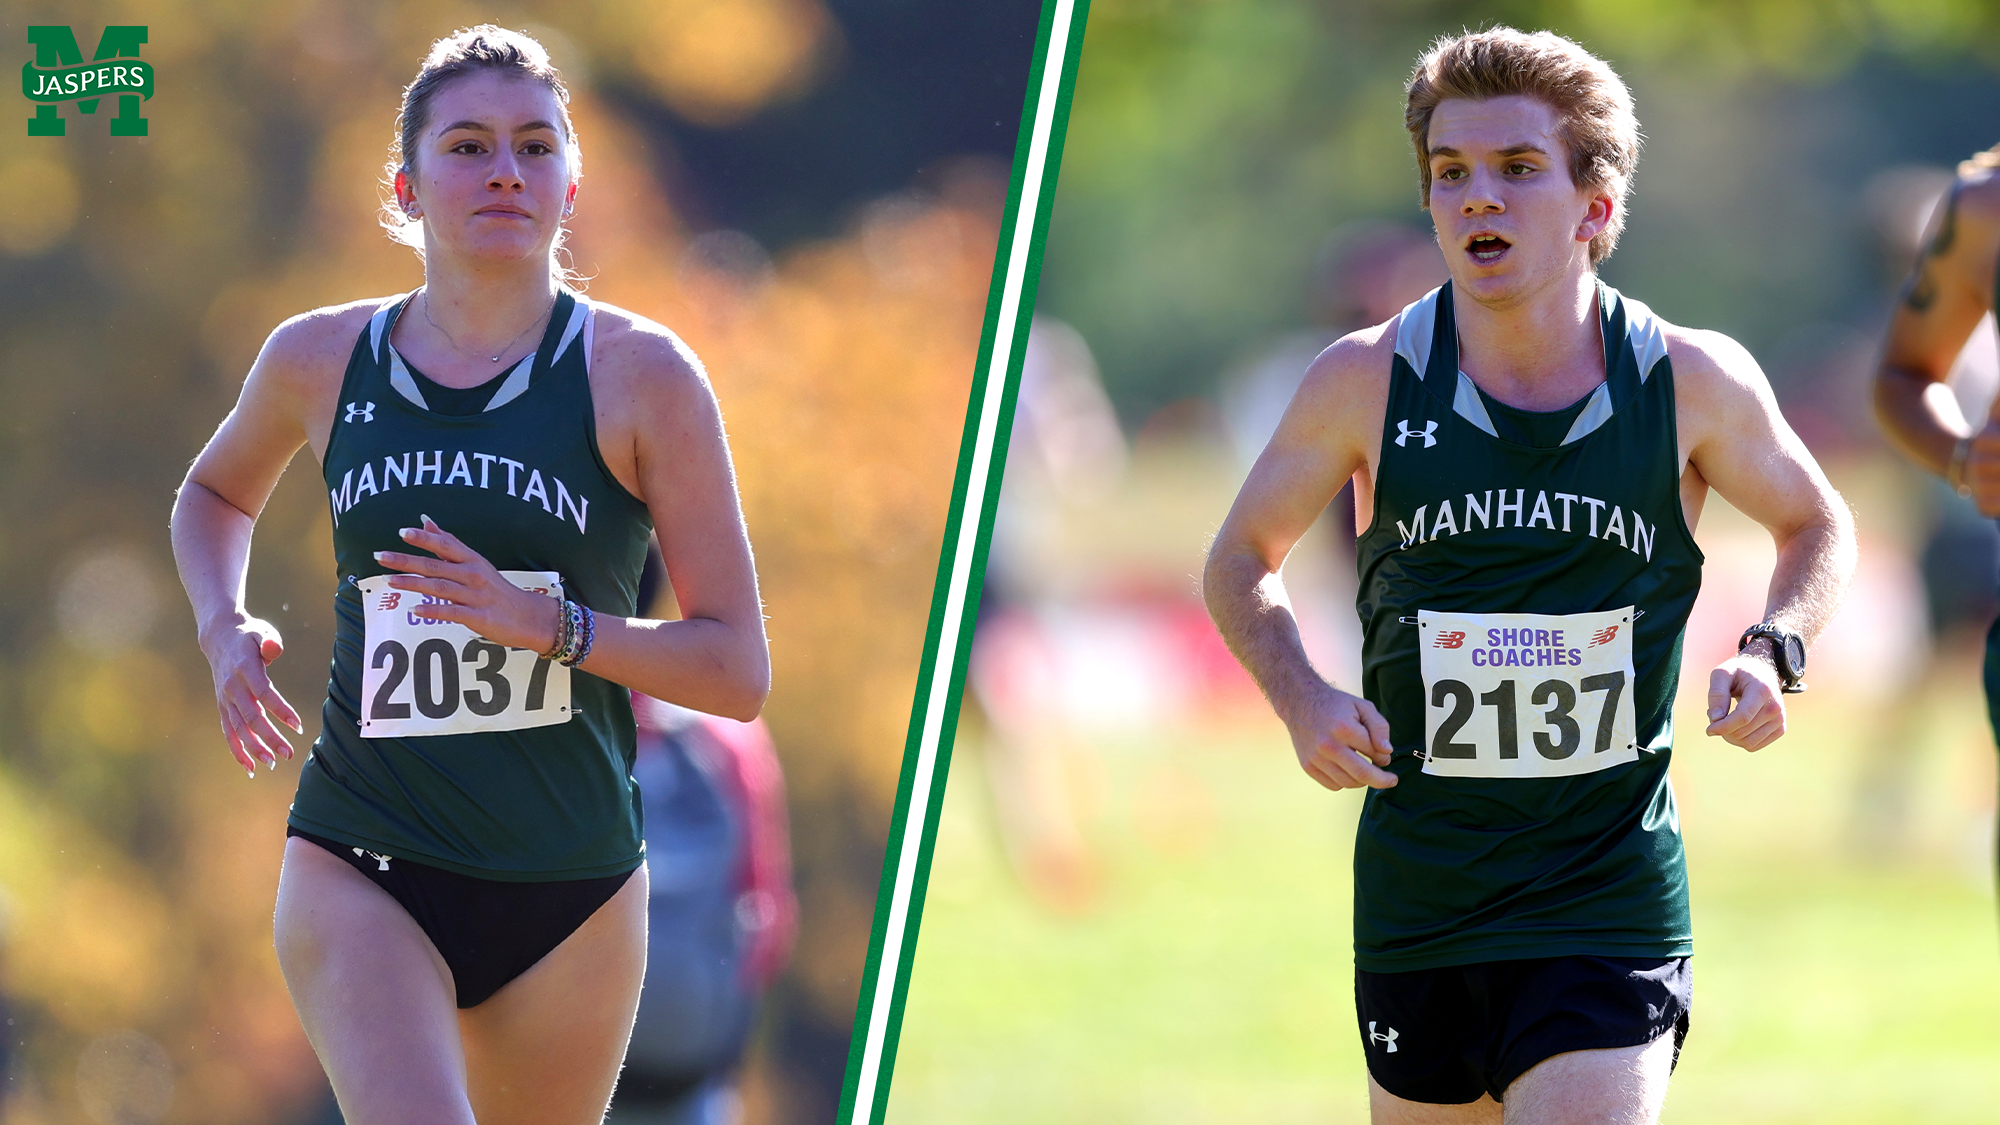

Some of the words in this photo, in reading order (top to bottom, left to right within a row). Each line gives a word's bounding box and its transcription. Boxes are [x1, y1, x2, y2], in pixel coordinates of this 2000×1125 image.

[330, 450, 589, 535] MANHATTAN
[1396, 488, 1656, 563] MANHATTAN
[1472, 648, 1582, 667] COACHES
[1487, 628, 1564, 647] SHORE
[370, 638, 553, 719] 2037
[1431, 670, 1625, 760] 2137
